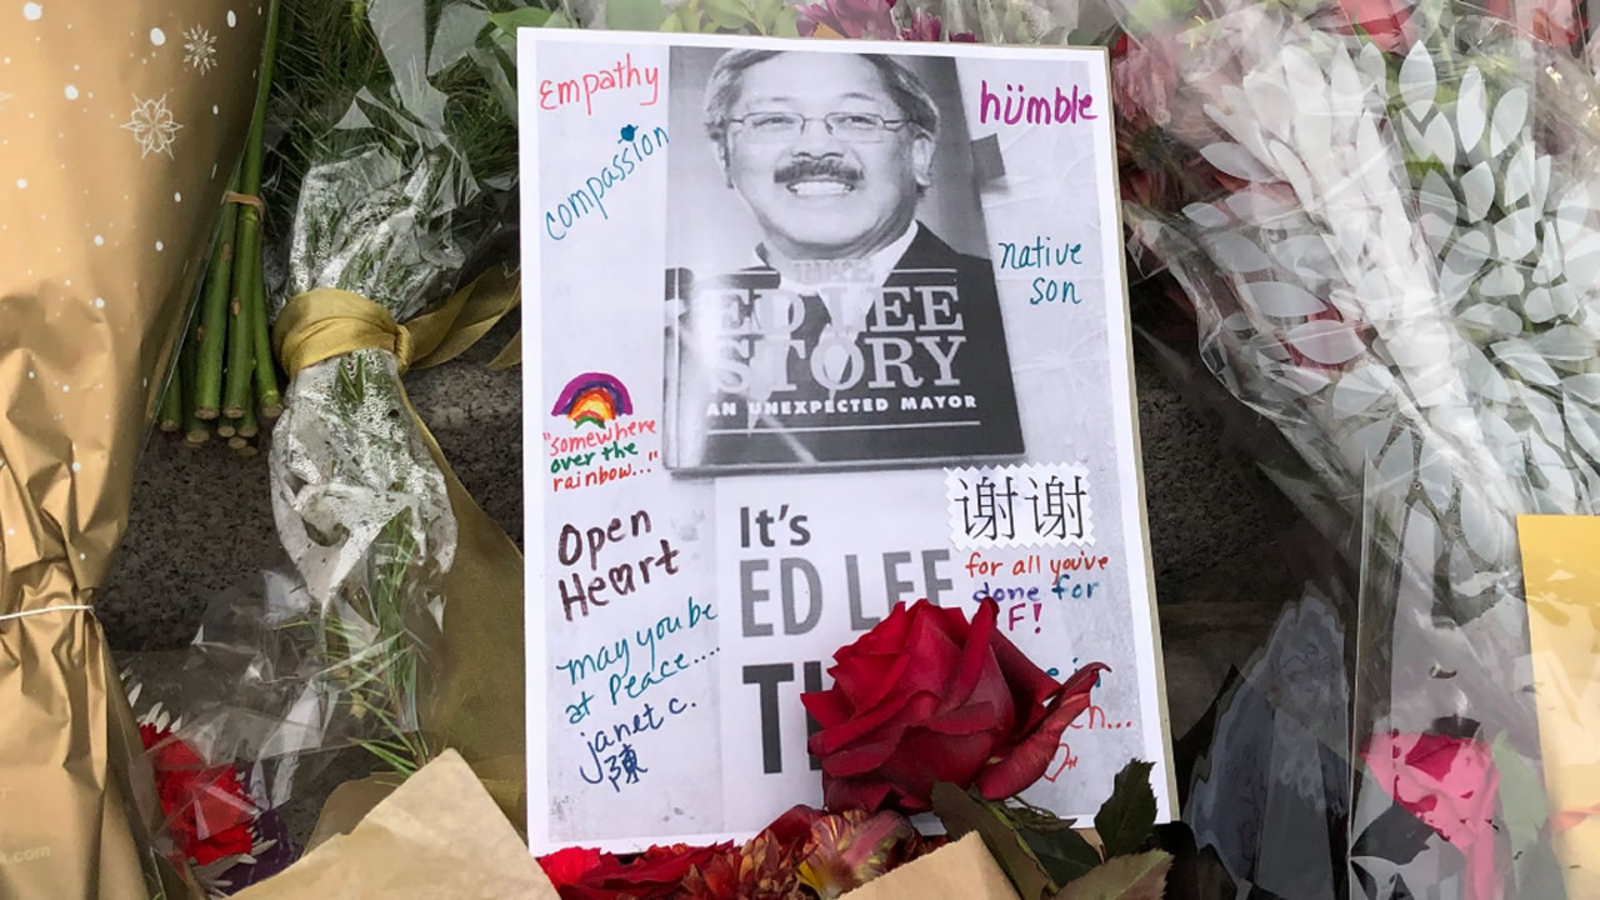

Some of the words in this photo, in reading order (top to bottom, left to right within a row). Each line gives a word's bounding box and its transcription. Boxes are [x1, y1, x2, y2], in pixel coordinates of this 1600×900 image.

[540, 52, 659, 115] Empathy
[998, 235, 1082, 270] native
[1030, 276, 1082, 305] son
[714, 335, 966, 392] STORY
[707, 401, 737, 417] AN
[749, 397, 889, 415] UNEXPECTED
[901, 395, 978, 411] MAYOR
[550, 452, 596, 473] over
[601, 441, 638, 461] the
[740, 504, 811, 548] It's
[954, 475, 1087, 541] 谢谢
[558, 510, 652, 571] Open
[558, 539, 680, 622] Heart
[965, 551, 1004, 578] for
[1012, 555, 1041, 576] all
[740, 557, 823, 637] ED
[972, 581, 1040, 602] done
[1051, 573, 1099, 600] for
[1008, 603, 1042, 634] F!
[556, 638, 630, 685] may
[636, 616, 684, 672] you
[688, 596, 718, 628] be
[565, 691, 594, 724] at
